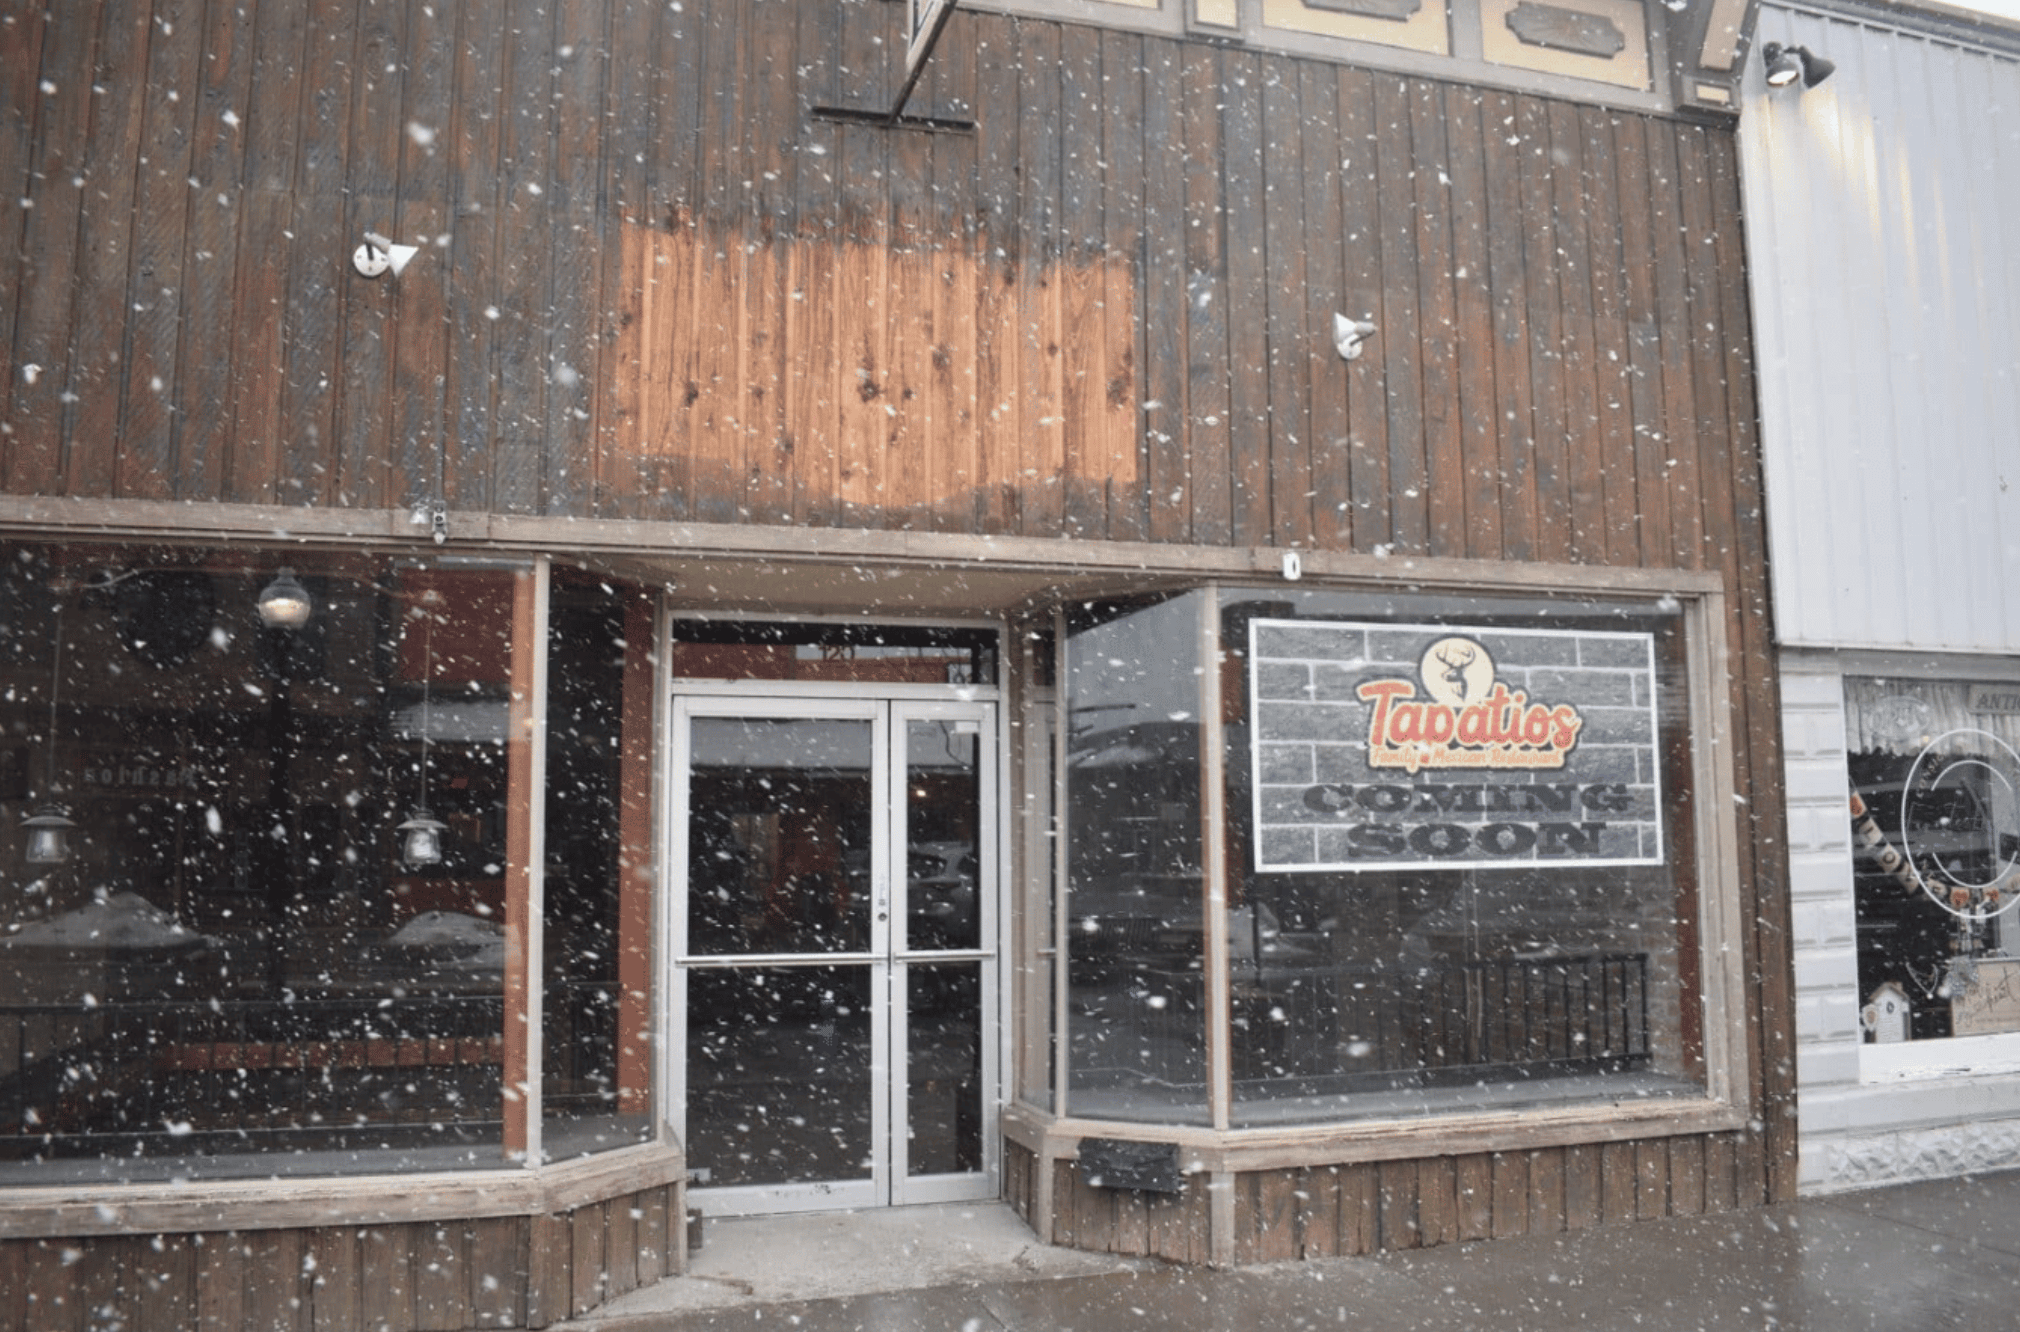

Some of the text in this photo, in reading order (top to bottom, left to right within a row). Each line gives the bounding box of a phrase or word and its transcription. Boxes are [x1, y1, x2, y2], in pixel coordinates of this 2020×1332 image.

[1359, 680, 1581, 758] Tapatios
[1303, 784, 1634, 813] COMING
[1347, 821, 1607, 856] SOON
